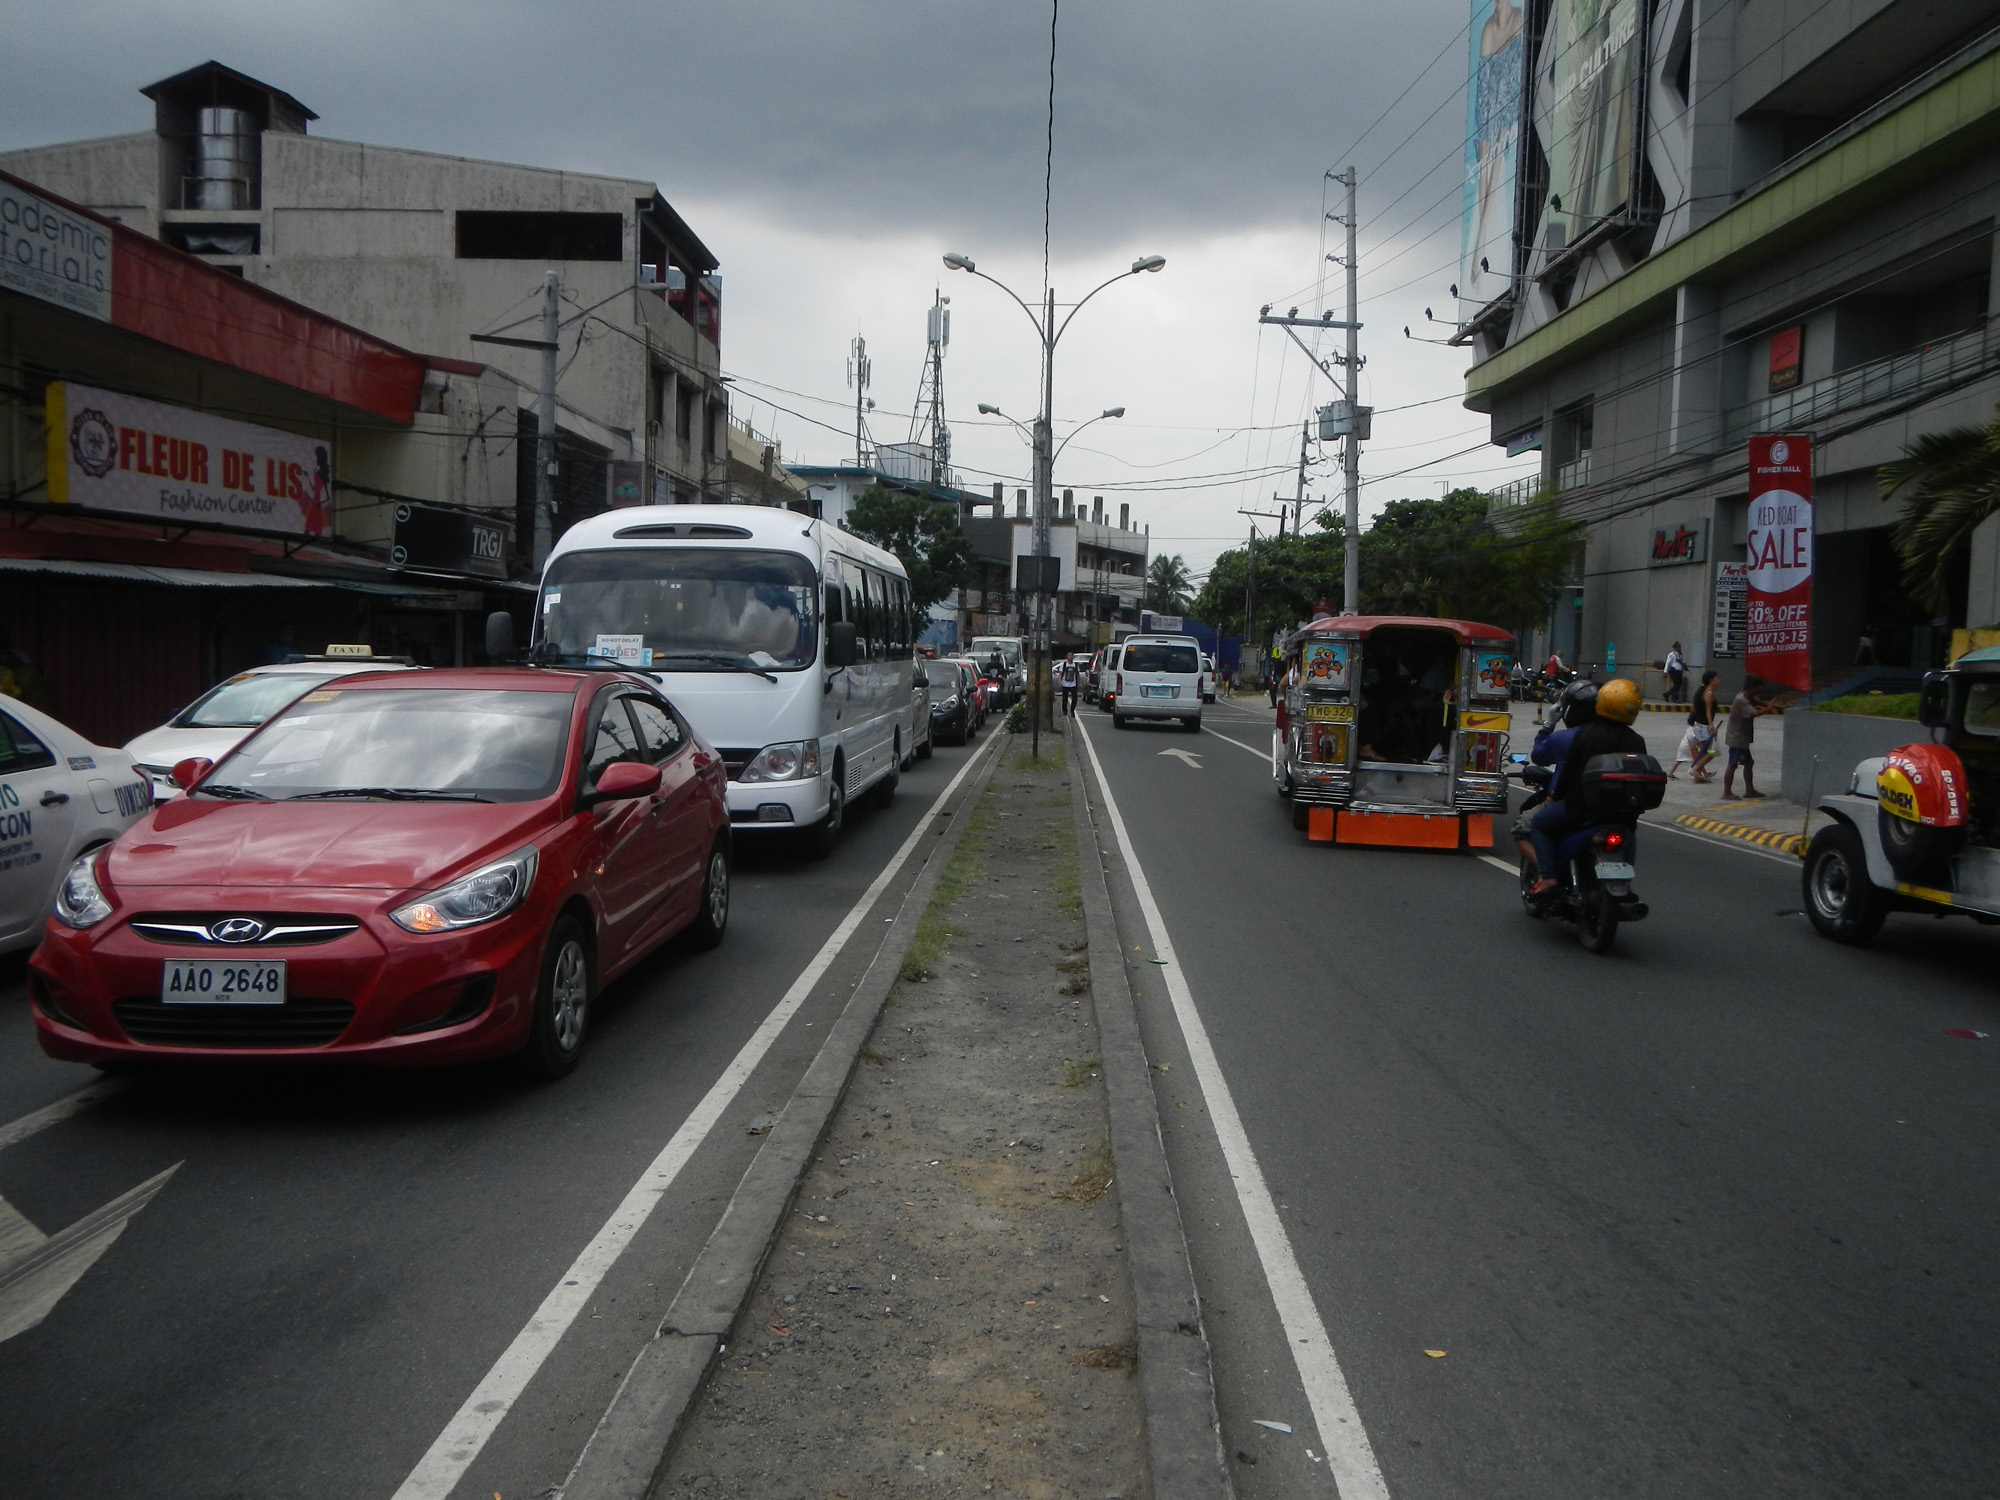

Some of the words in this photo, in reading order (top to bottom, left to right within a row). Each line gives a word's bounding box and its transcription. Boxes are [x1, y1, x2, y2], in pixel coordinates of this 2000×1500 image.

[1580, 9, 1635, 89] CULTURE
[119, 426, 209, 485] FLEUR
[222, 448, 255, 493] DE
[266, 458, 304, 500] LIS
[1757, 466, 1782, 474] FISHER
[1783, 465, 1802, 473] MALL
[159, 488, 223, 513] Fashion
[227, 493, 277, 515] Center
[1748, 527, 1807, 571] SALE
[1748, 607, 1774, 623] 50%
[1778, 604, 1807, 621] OFF
[1748, 632, 1771, 646] MAY
[1772, 630, 1807, 644] 13-15
[1755, 622, 1785, 630] SELECTED
[333, 646, 361, 654] TAXI
[1877, 783, 1914, 810] OLDEX
[221, 968, 279, 992] 2648
